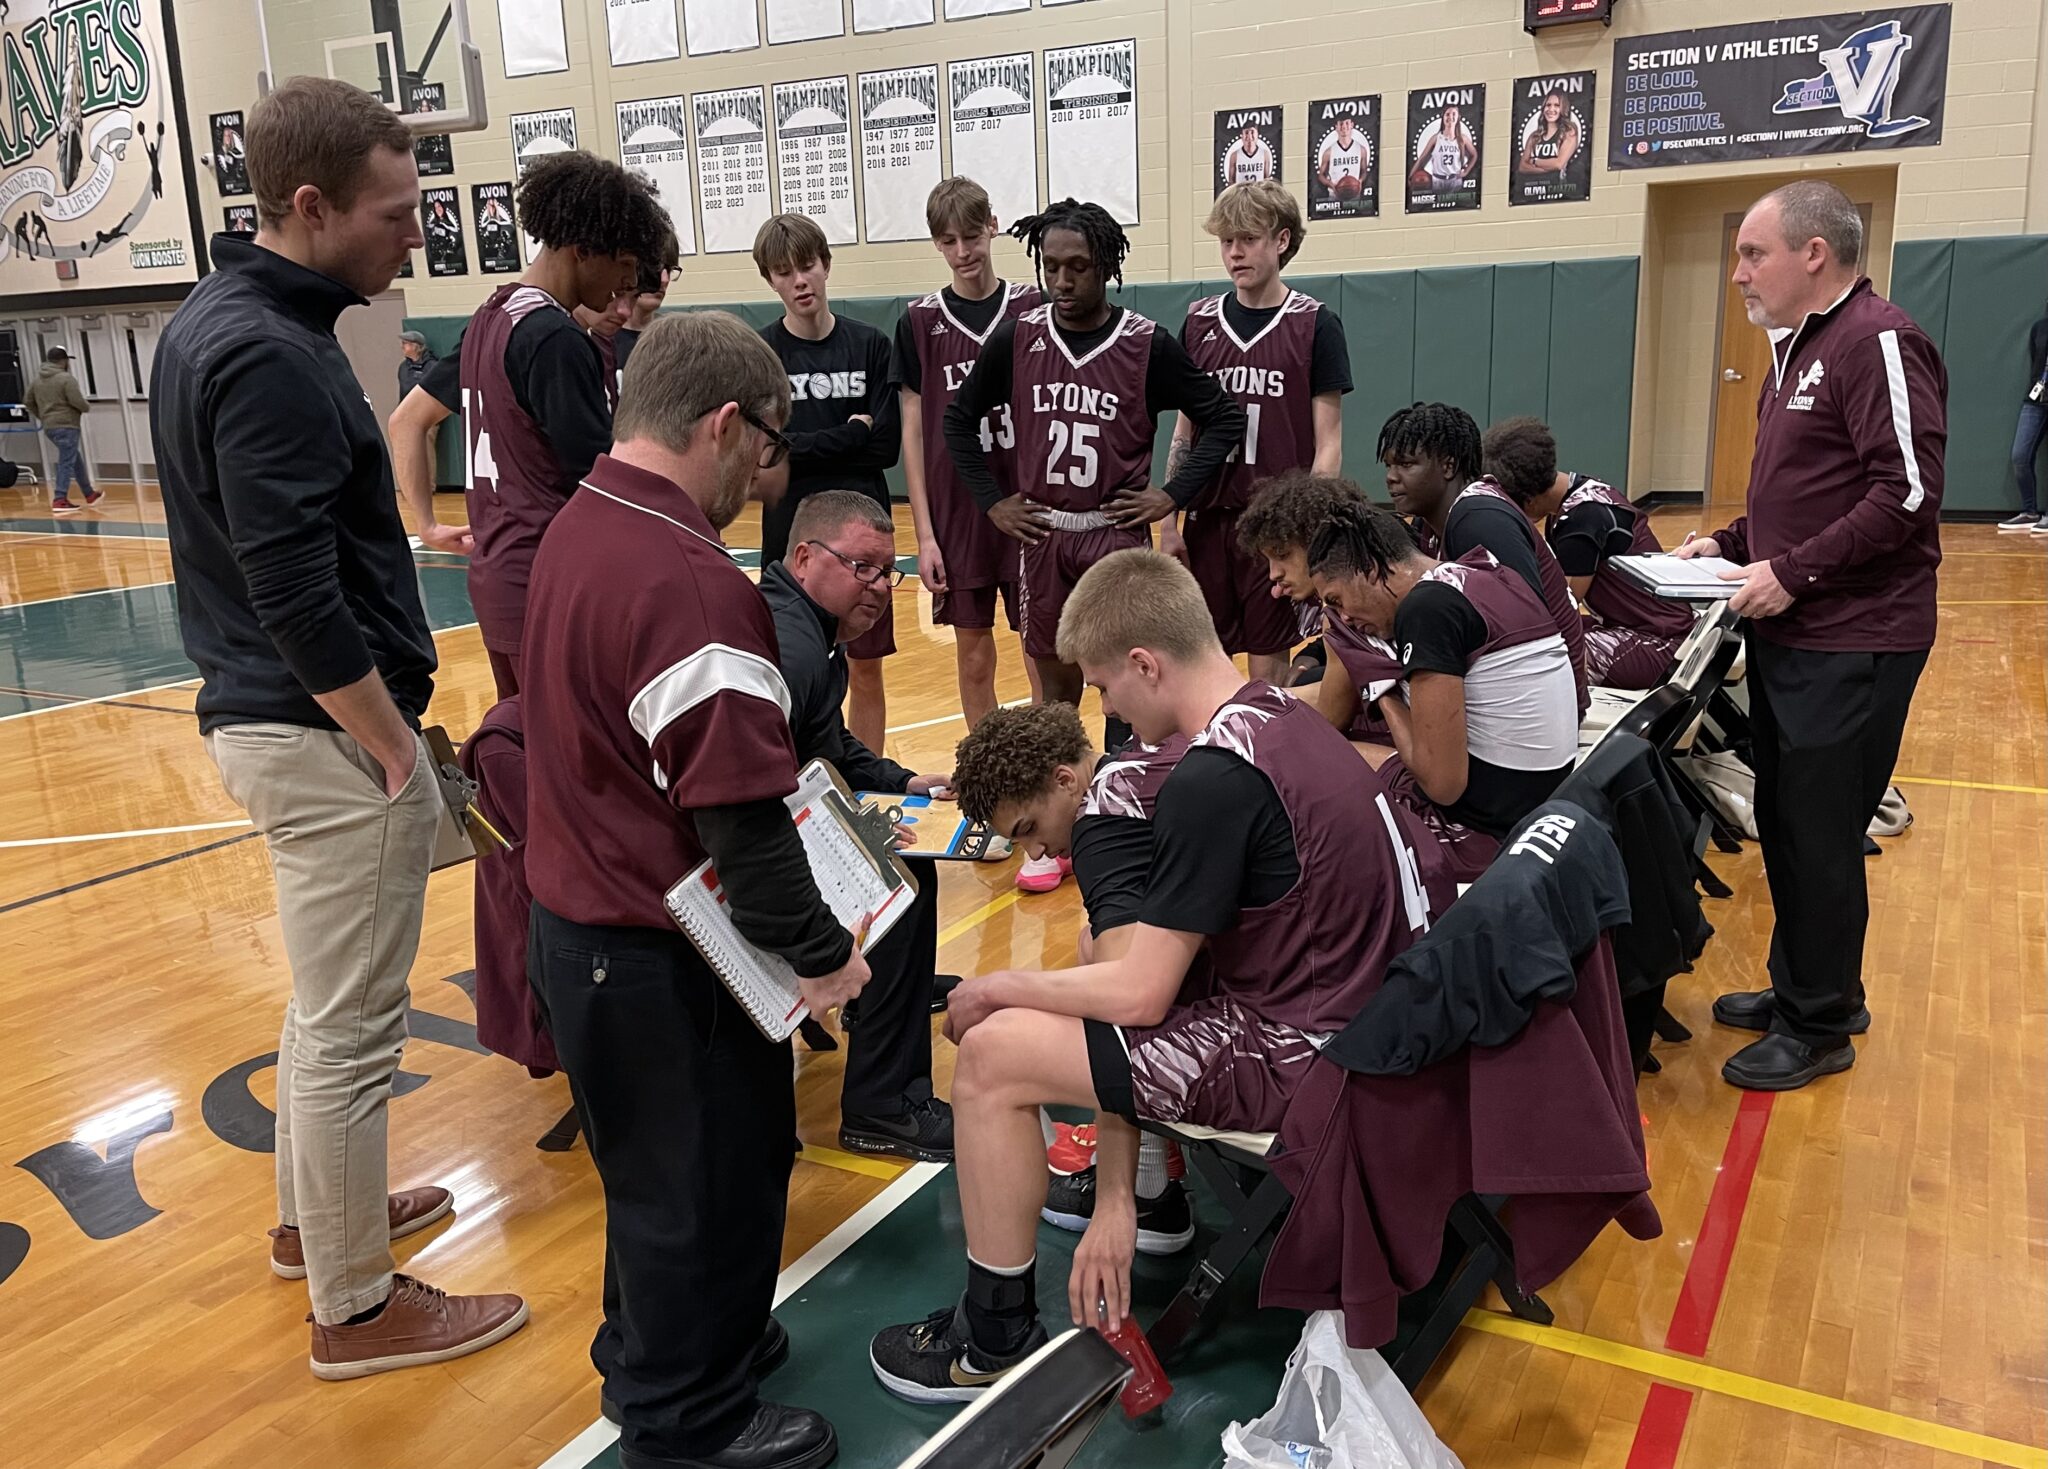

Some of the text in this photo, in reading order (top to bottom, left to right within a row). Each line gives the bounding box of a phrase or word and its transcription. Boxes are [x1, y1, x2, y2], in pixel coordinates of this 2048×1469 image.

[1628, 34, 1819, 71] SECTION V ATHLETICS
[1049, 51, 1132, 98] CHAMPIONS
[1626, 70, 1698, 93] BE LOUD,
[0, 0, 148, 168] AVES
[952, 63, 1030, 109] CHAMPIONS
[1528, 76, 1583, 98] AVON
[412, 87, 439, 101] AVON
[862, 75, 936, 119] CHAMPIONS
[1062, 94, 1118, 109] TENNIS
[1422, 89, 1474, 109] AVON
[1786, 85, 1834, 105] SECTION
[777, 85, 847, 128] CHAMPIONS
[955, 103, 1029, 120] GIRLS TRACK
[1322, 100, 1370, 119] AVON
[1624, 92, 1707, 116] BE PROUD,
[696, 96, 763, 136] CHAMPIONS
[864, 114, 936, 130] BASEBALL
[1052, 105, 1129, 123] 2010 2011 2017
[1227, 110, 1273, 129] AVON
[620, 106, 684, 144] CHAMPIONS
[890, 129, 909, 139] 1977
[914, 126, 934, 137] 2002
[955, 119, 1001, 132] 2007 2017
[1623, 112, 1725, 138] BE POSITIVE.
[1784, 124, 1864, 139] WWW.SECTIONV.ORG
[515, 118, 574, 155] CHAMPIONS
[745, 144, 762, 154] 2010
[805, 151, 823, 161] 2001
[829, 149, 847, 159] 2002
[866, 140, 934, 155] 2014 2016 2017
[646, 154, 662, 163] 2014
[702, 161, 719, 171] 2011
[867, 156, 910, 169] 2018 2021
[1333, 156, 1359, 167] BRAVES
[1443, 154, 1454, 166] 23
[747, 170, 763, 180] 2017
[806, 165, 823, 175] 2007
[1238, 162, 1263, 173] BRAVES
[57, 164, 111, 216] A LIFETIME
[807, 178, 825, 188] 2010
[830, 176, 848, 186] 2014
[427, 190, 453, 203] AVON
[480, 185, 507, 199] AVON
[831, 189, 849, 200] 2017
[230, 208, 253, 220] AVON
[808, 204, 826, 215] 2020
[130, 237, 182, 250] Sponsored by
[131, 251, 151, 268] AVON
[788, 370, 867, 401] YONS
[1206, 366, 1284, 398] YONS
[1033, 382, 1119, 421] LYONS
[1046, 419, 1101, 488] 25
[1509, 814, 1577, 865] BELL
